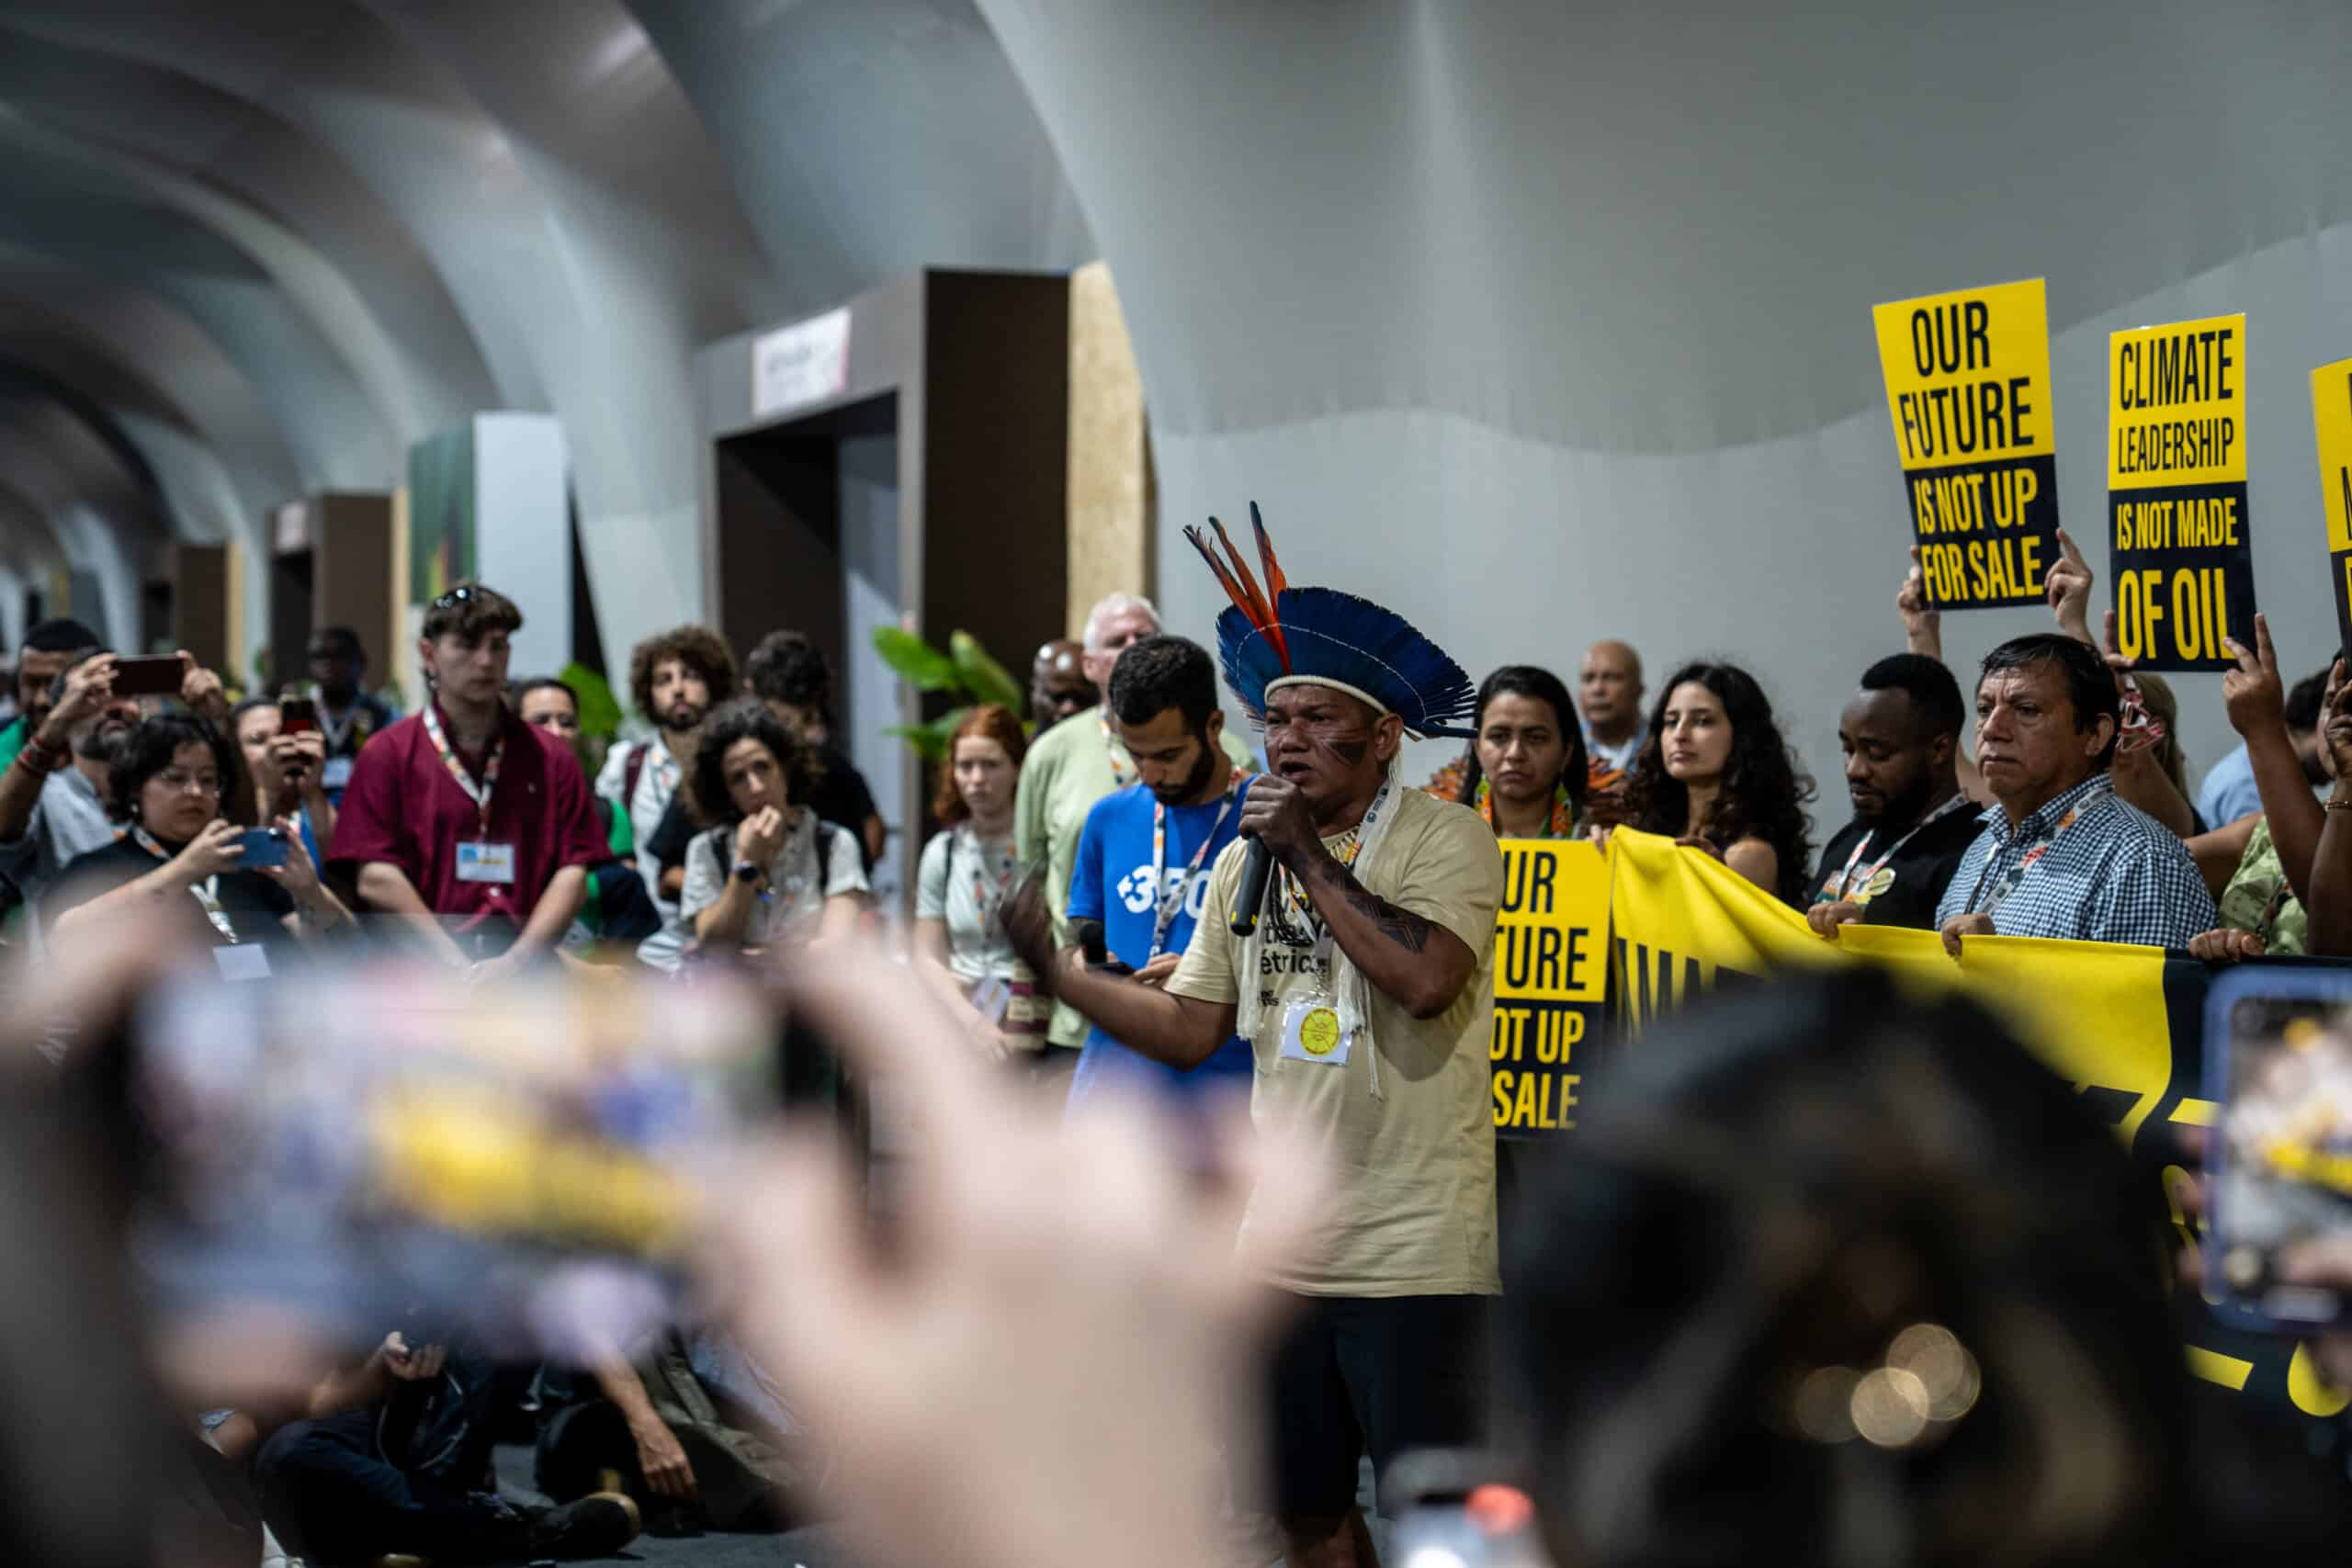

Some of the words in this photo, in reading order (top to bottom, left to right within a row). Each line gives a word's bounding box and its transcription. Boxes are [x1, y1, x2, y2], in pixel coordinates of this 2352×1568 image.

[1912, 300, 1991, 378] OUR
[2120, 329, 2233, 411] CLIMATE
[1898, 377, 2034, 458] FUTURE
[2118, 417, 2234, 473] LEADERSHIP
[1914, 478, 1936, 535] IS
[1935, 473, 1984, 533] NOT
[1990, 468, 2038, 527] UP
[2117, 502, 2132, 550] IS
[2135, 501, 2173, 549] NOT
[2177, 497, 2239, 547] MADE
[1921, 543, 1969, 603] FOR
[1968, 536, 2044, 600] SALE
[2118, 570, 2164, 660] OF
[2172, 568, 2236, 660] OIL
[1123, 865, 1213, 919] 350
[1502, 851, 1556, 913] UR
[1497, 925, 1589, 991] URE
[1489, 1008, 1531, 1062] OT
[1536, 1010, 1585, 1064] UP
[1493, 1069, 1580, 1130] SALE
